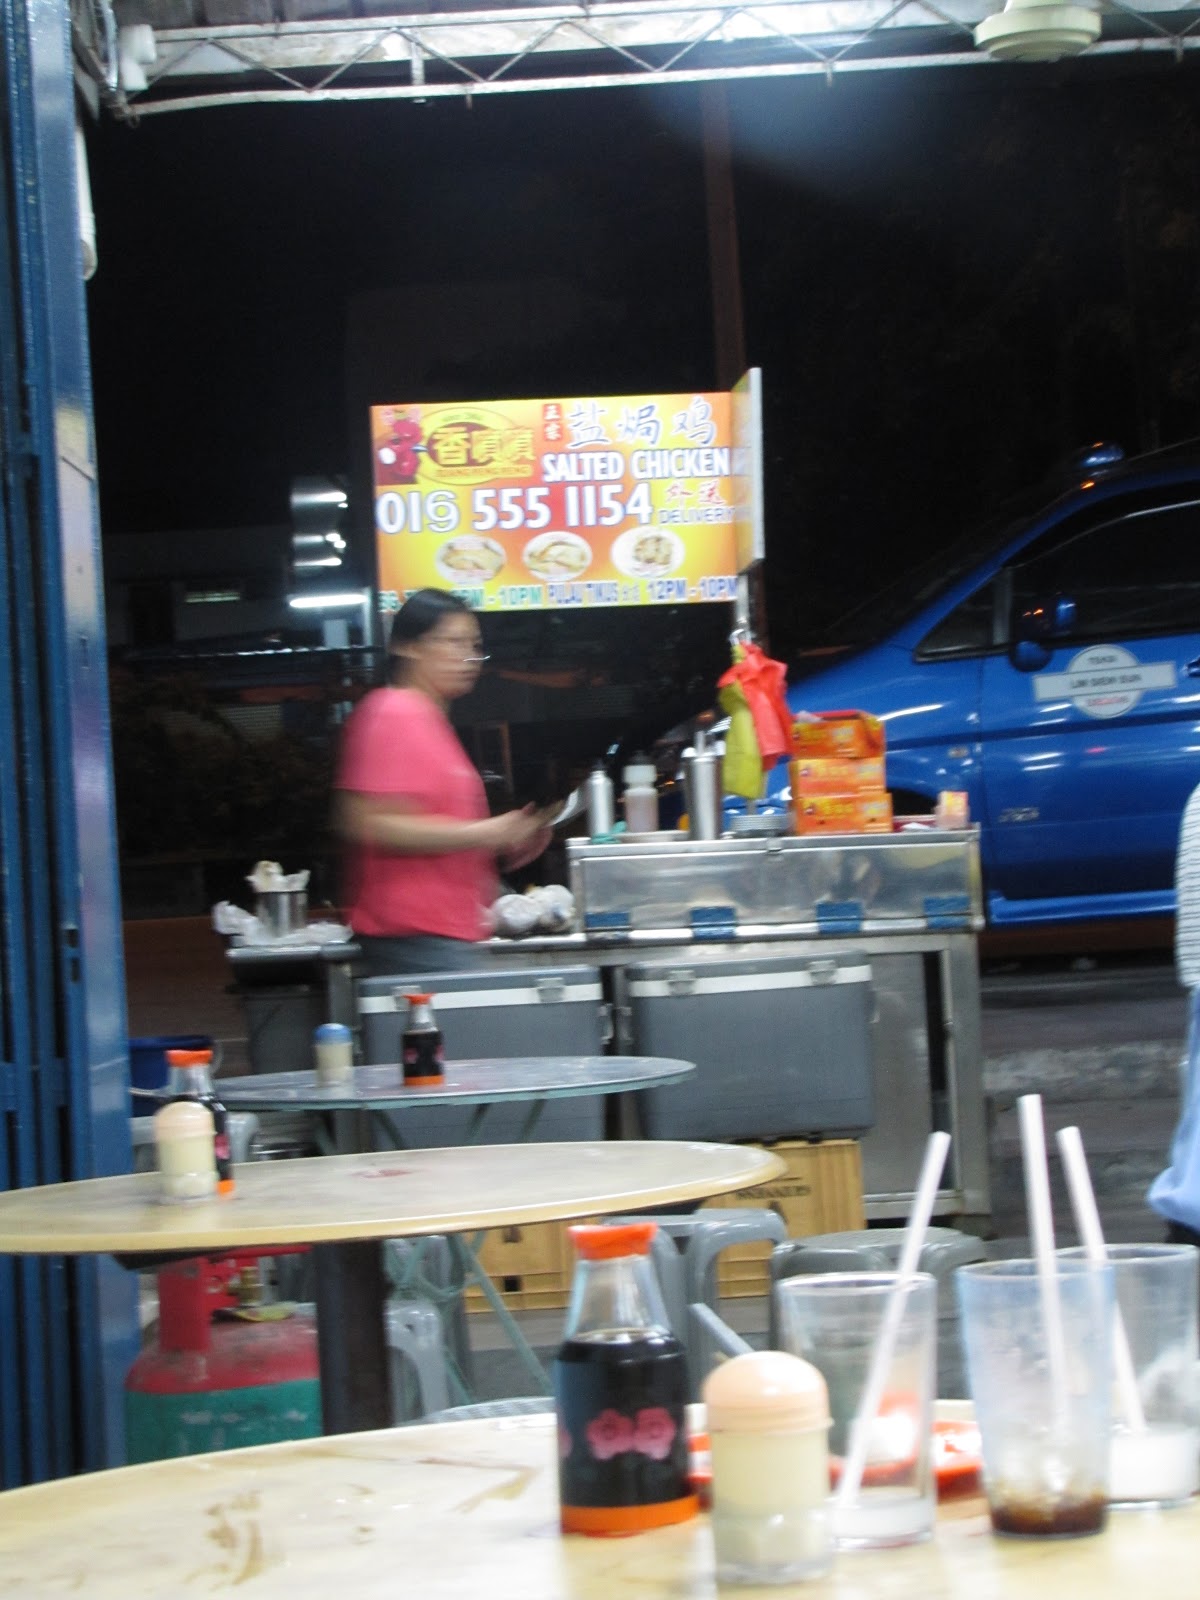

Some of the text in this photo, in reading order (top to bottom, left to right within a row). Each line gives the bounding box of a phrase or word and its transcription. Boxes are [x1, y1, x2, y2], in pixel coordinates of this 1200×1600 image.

[567, 397, 717, 449] 盐焗鸡
[542, 447, 730, 482] SALTED CHICKEN
[472, 487, 551, 531] 555
[566, 482, 653, 527] 1154
